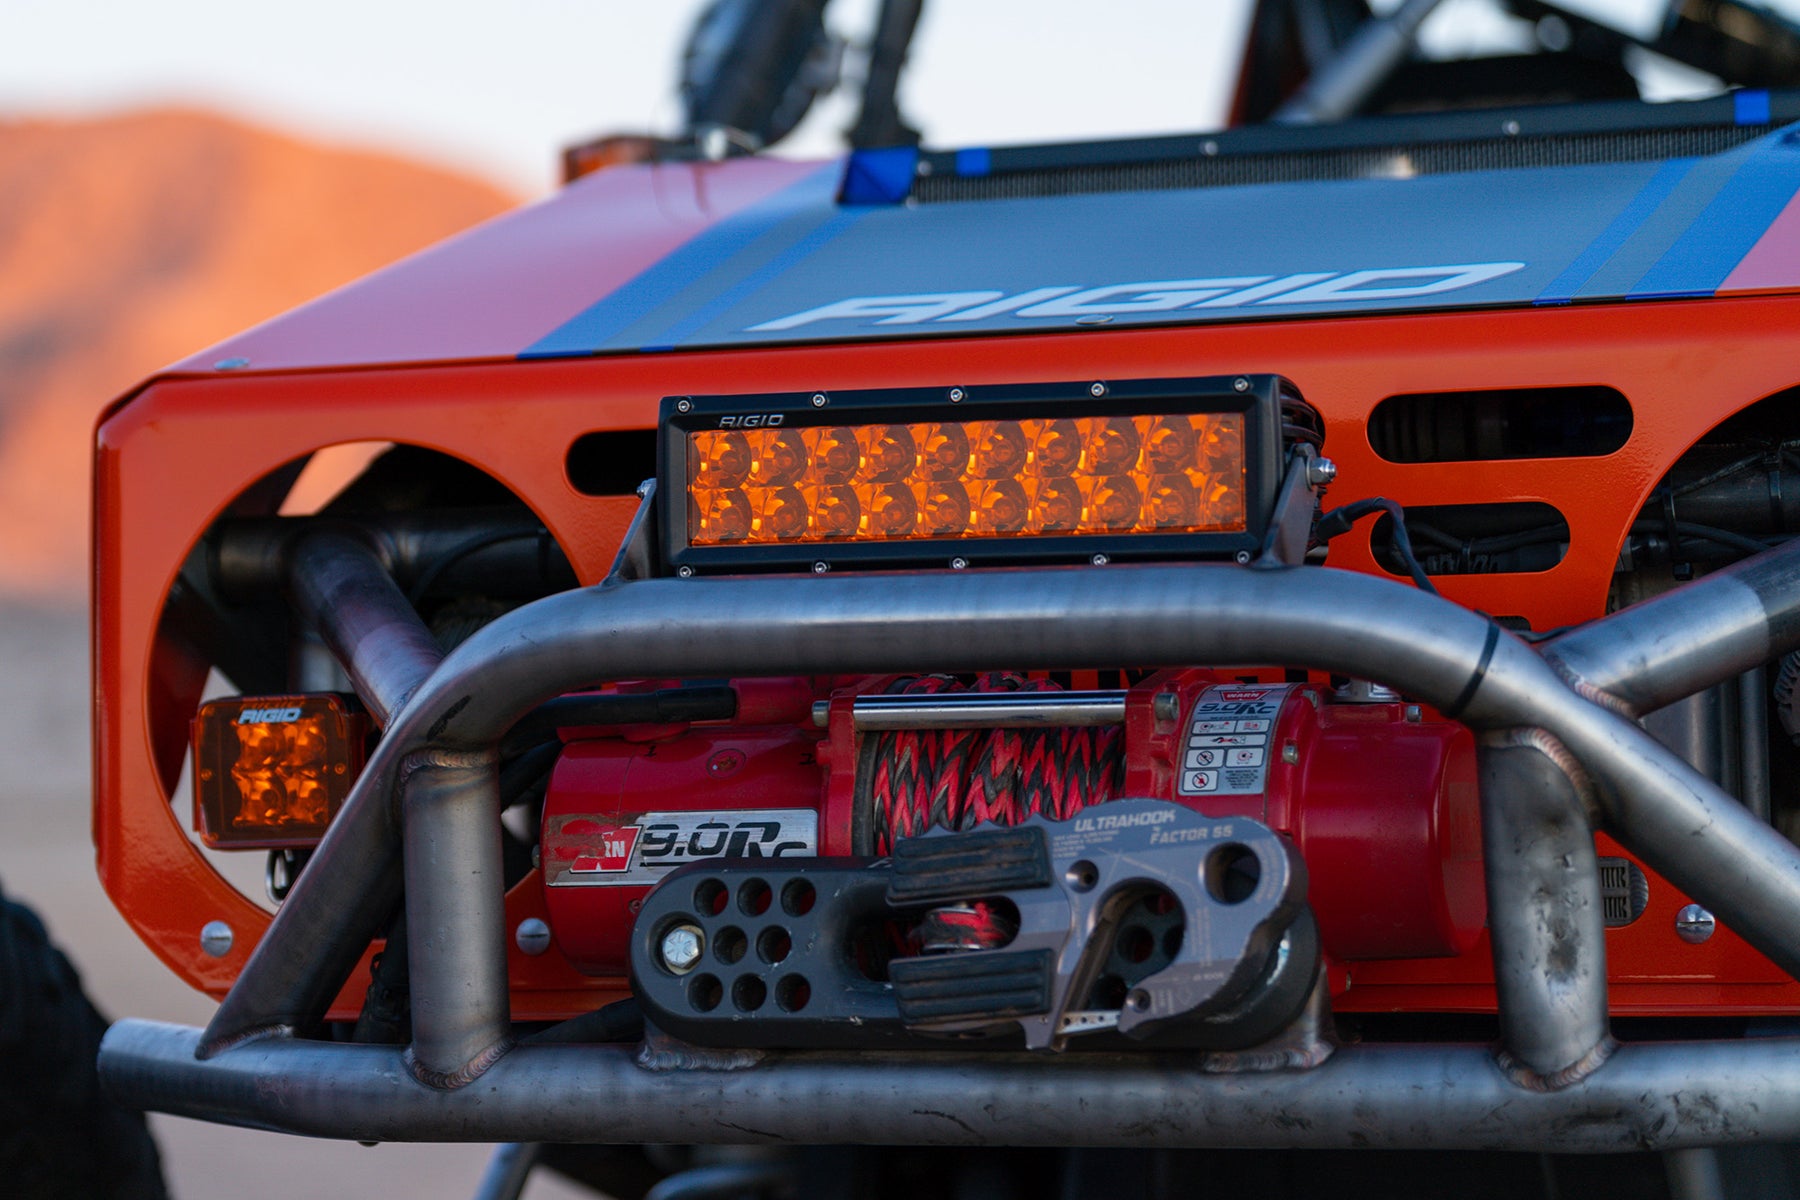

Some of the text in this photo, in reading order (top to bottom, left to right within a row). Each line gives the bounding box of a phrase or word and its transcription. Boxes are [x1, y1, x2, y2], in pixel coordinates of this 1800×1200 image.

[742, 261, 1526, 332] RIGID
[719, 414, 784, 428] RIGID
[238, 707, 302, 724] RIGID
[1074, 809, 1176, 833] ULTRAHOOK
[1150, 827, 1208, 845] FACTOR
